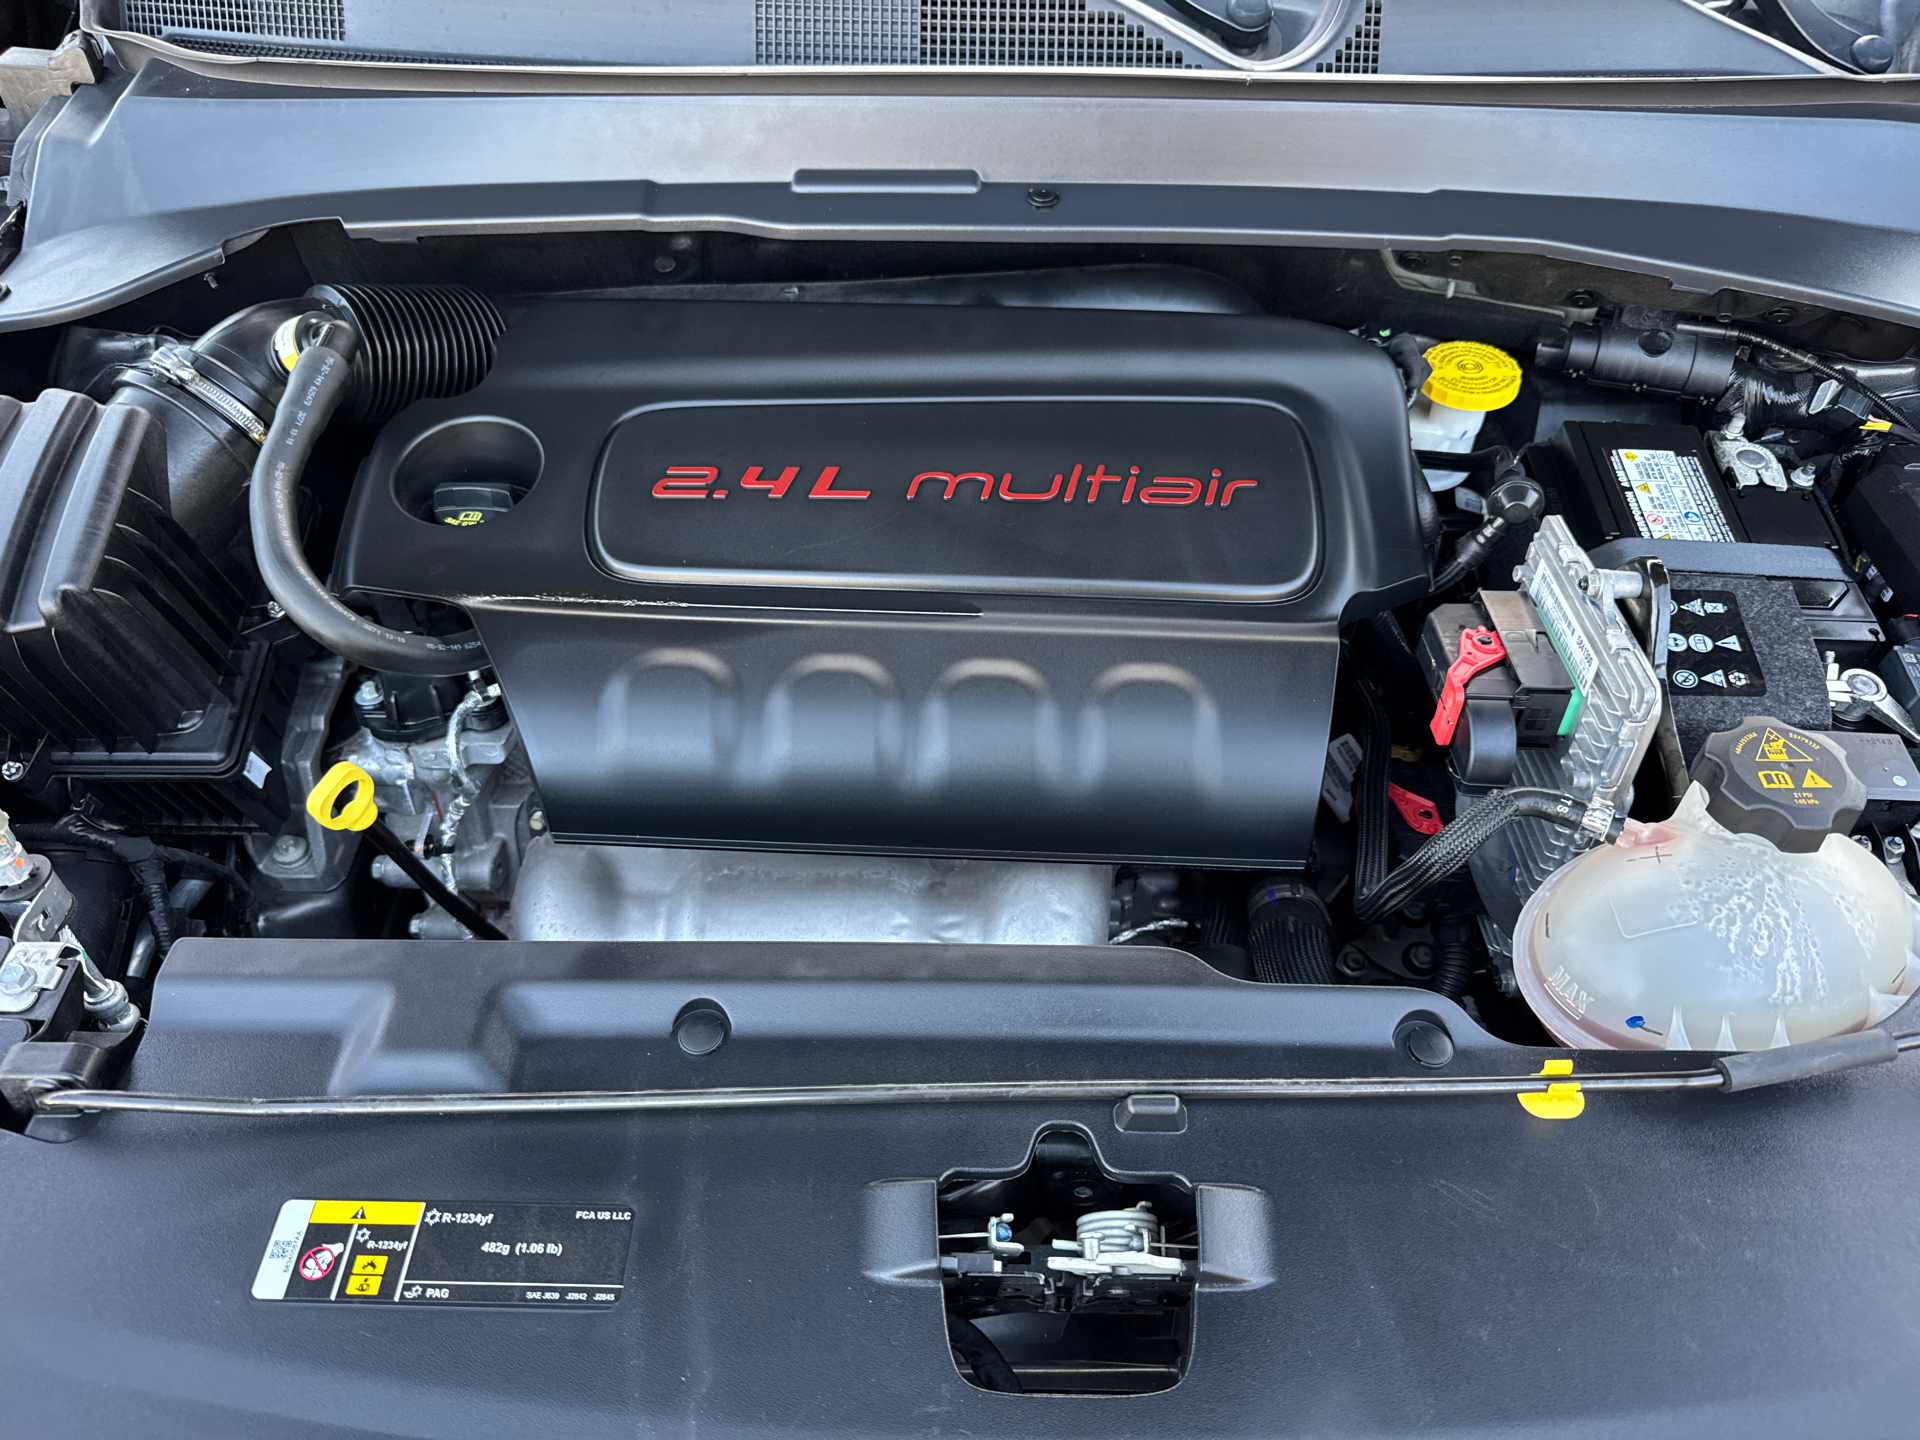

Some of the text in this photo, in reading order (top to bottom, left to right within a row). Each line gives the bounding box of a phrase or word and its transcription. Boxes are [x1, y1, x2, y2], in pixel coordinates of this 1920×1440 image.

[905, 464, 1258, 506] multiair
[1548, 965, 1595, 1015] MAX
[442, 1212, 494, 1226] R-1234yf
[576, 1210, 632, 1220] FCA US LLC
[366, 1240, 408, 1252] R-1234yf
[481, 1242, 563, 1256] 482g (1.06 lb)
[426, 1288, 450, 1298] PAG
[526, 1291, 542, 1300] SAE
